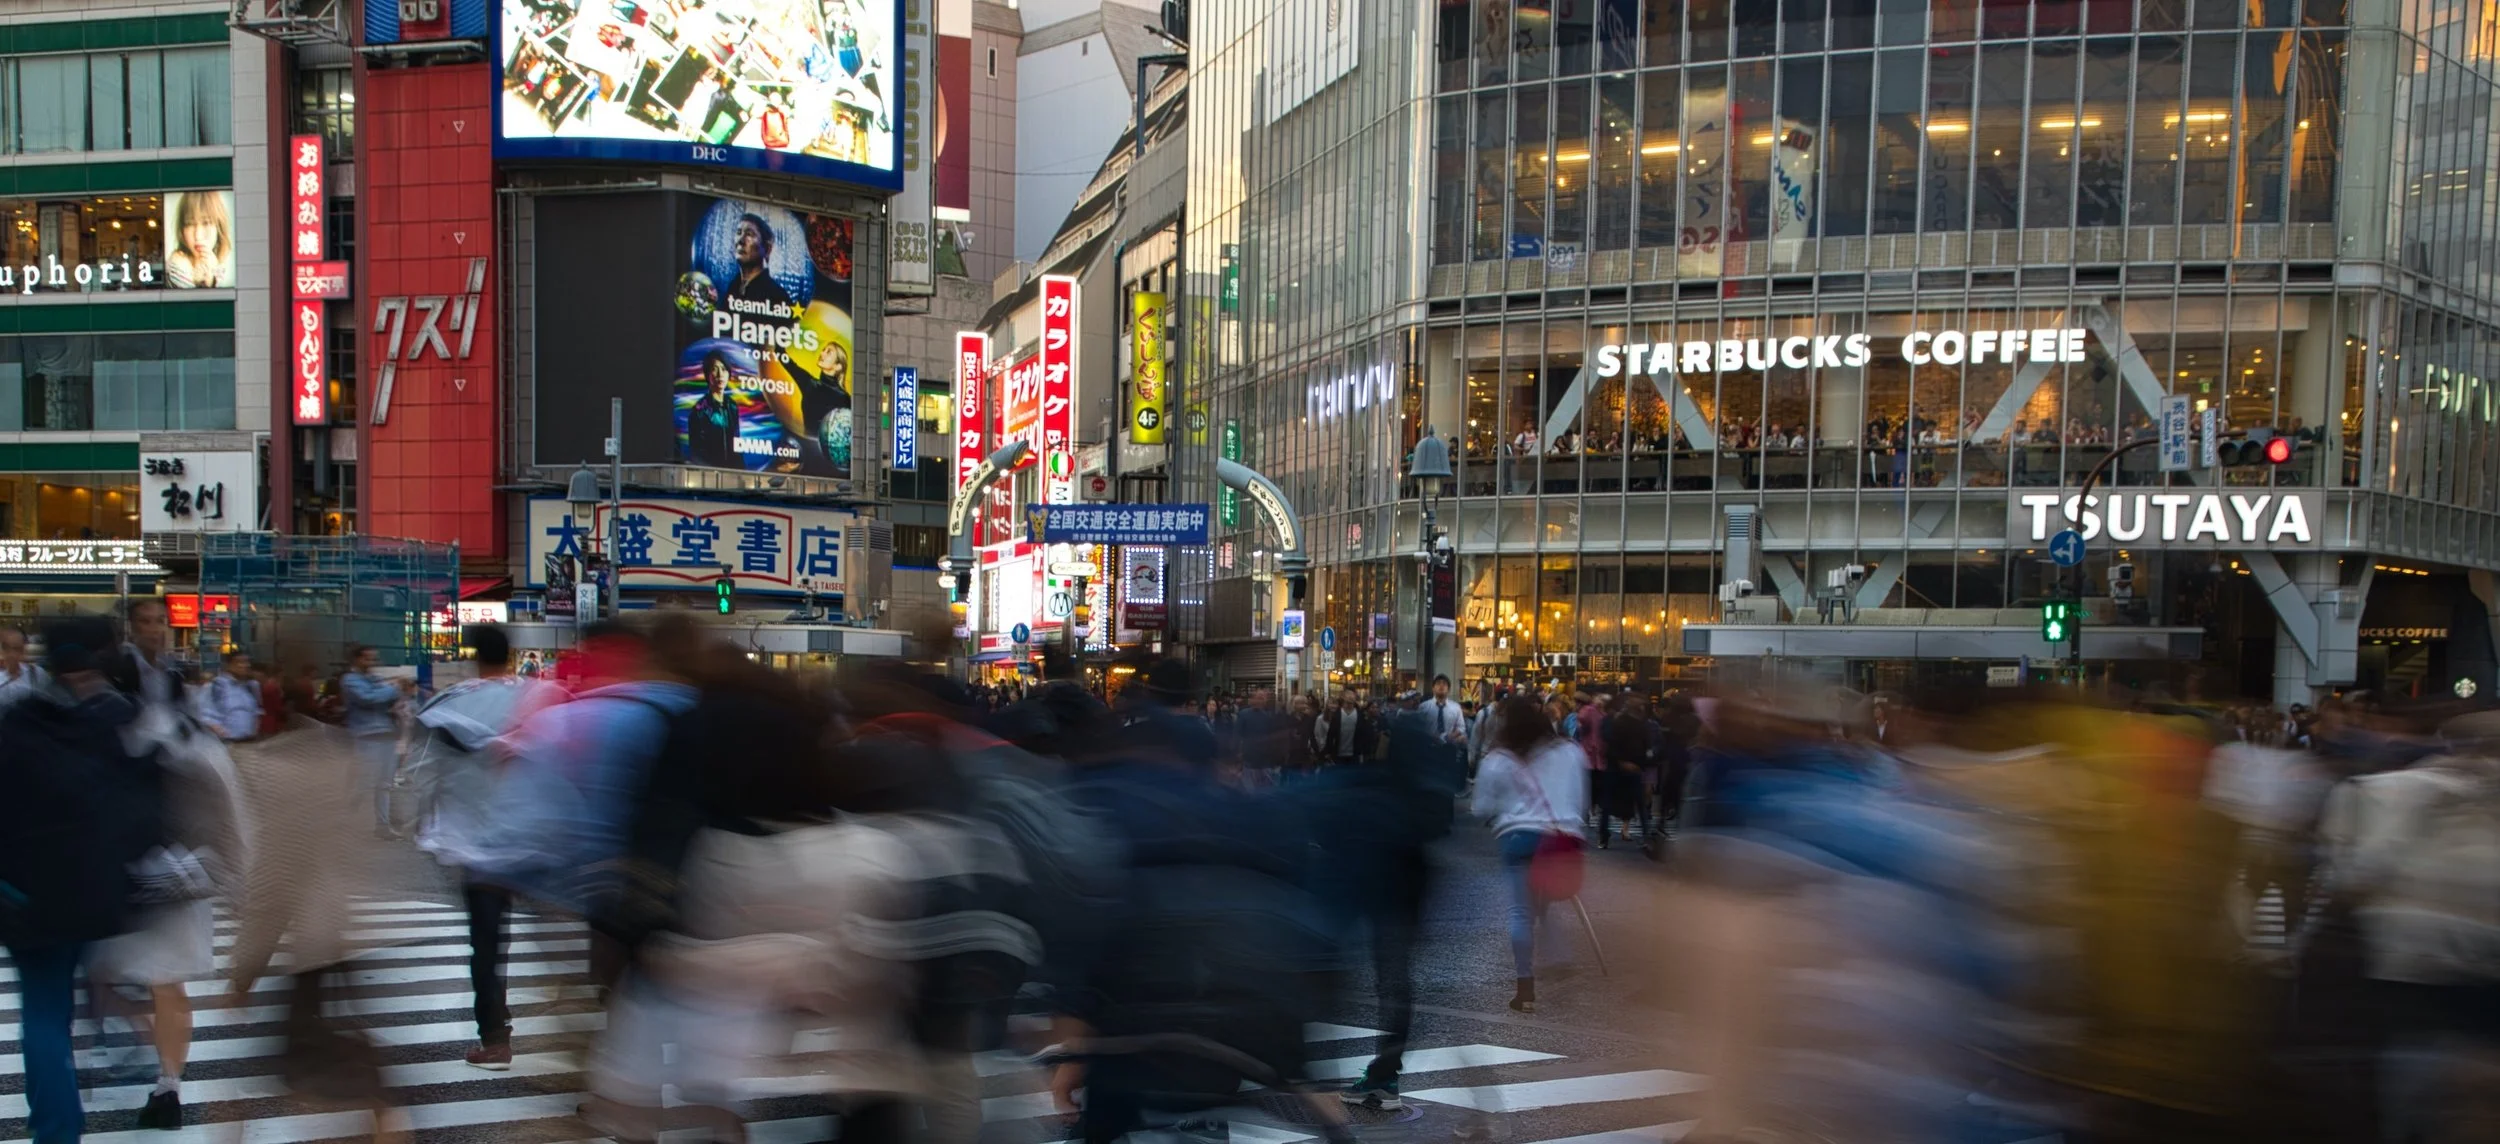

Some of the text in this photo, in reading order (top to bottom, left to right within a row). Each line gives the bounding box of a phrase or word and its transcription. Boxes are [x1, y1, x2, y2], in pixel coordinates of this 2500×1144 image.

[692, 145, 727, 162] DHC
[728, 294, 792, 319] teamLab
[712, 310, 819, 352] Planets
[744, 348, 790, 364] TOKYO
[1046, 295, 1069, 416] カラオケ
[1597, 328, 2086, 377] STARBUCKS COFFEE
[738, 375, 795, 396] TOYOSU
[963, 352, 977, 418] BIG ECHO
[897, 373, 915, 465] 大盛堂商事ビル
[1138, 410, 1157, 426] 4F
[733, 436, 799, 459] DMM.com
[144, 458, 184, 476] うなぎ
[162, 481, 223, 519] 松川
[1049, 509, 1204, 532] 全国交通安全運動実施中
[2021, 494, 2312, 543] TSUTAYA
[546, 514, 843, 577] 大盛堂書店
[2396, 628, 2448, 638] COFFEE
